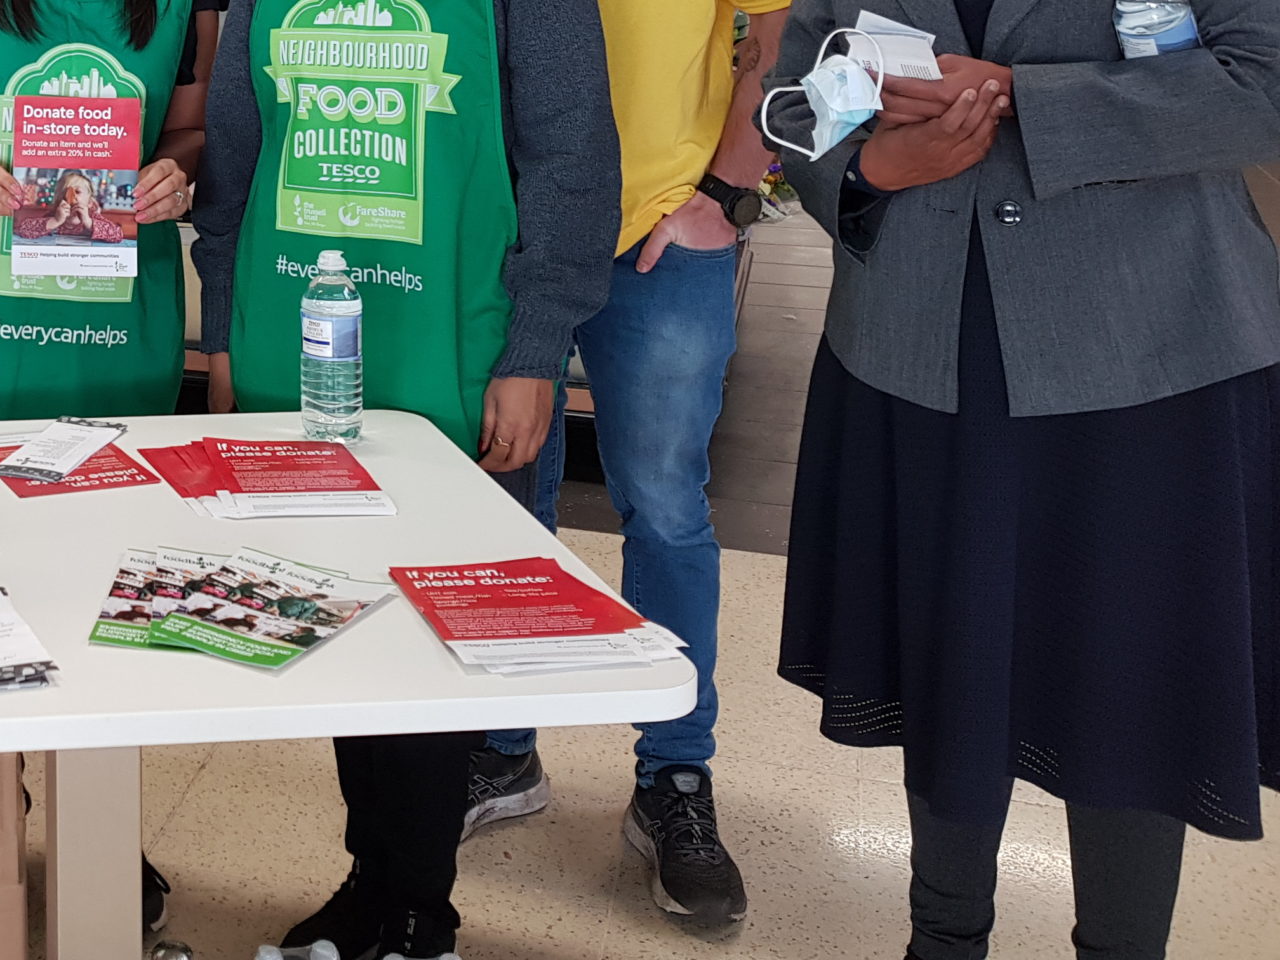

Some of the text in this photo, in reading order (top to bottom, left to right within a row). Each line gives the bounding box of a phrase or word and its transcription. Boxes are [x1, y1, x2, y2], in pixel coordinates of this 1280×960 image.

[279, 39, 429, 71] NEIGHBOURHOOD
[297, 83, 406, 123] FOOD
[23, 104, 112, 120] Donate food
[22, 121, 128, 140] in-store today.
[22, 139, 49, 147] Donate
[92, 141, 109, 149] we'll
[293, 127, 407, 166] COLLECTION
[67, 149, 84, 157] 20%
[318, 162, 381, 180] TESCO
[356, 205, 407, 219] FareShare
[19, 251, 39, 259] TESCO
[276, 254, 423, 293] #evecanhelps
[217, 442, 229, 451] If
[231, 444, 262, 452] you
[221, 449, 337, 458] please donate:
[88, 467, 139, 479] please
[102, 474, 133, 485] you
[135, 474, 147, 482] If
[406, 569, 505, 581] If you can,
[413, 575, 554, 589] please donate:
